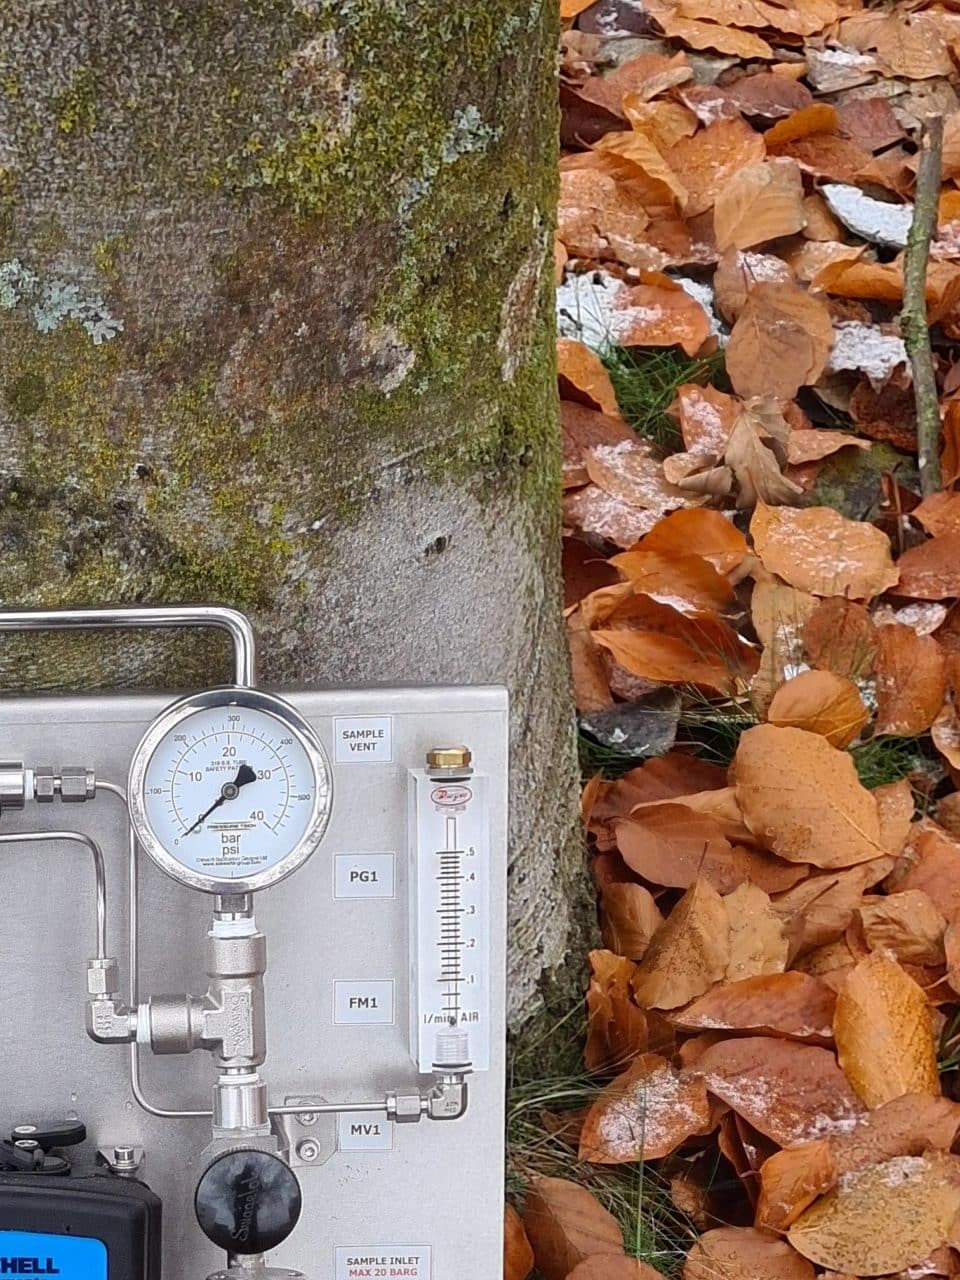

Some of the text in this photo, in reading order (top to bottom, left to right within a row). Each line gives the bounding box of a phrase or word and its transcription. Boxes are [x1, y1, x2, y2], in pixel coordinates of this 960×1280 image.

[174, 734, 186, 742] 200
[342, 729, 384, 740] SAMPLE
[280, 738, 293, 746] 400
[350, 742, 378, 752] VENT
[222, 746, 236, 757] 20
[189, 771, 202, 782] 10
[257, 769, 271, 780] 30
[249, 810, 264, 821] 40
[221, 832, 241, 844] bar
[222, 845, 240, 857] psi
[465, 847, 475, 856] .5
[350, 870, 378, 882] PG1
[465, 872, 475, 882] .4
[466, 905, 476, 915] .3
[466, 938, 476, 948] .2
[466, 975, 475, 985] .1
[349, 997, 378, 1009] FM1
[461, 1011, 479, 1023] AIR
[351, 1124, 381, 1136] MV1
[346, 1256, 421, 1266] SAMPLE INLET
[349, 1268, 418, 1277] MAX 20 BARG
